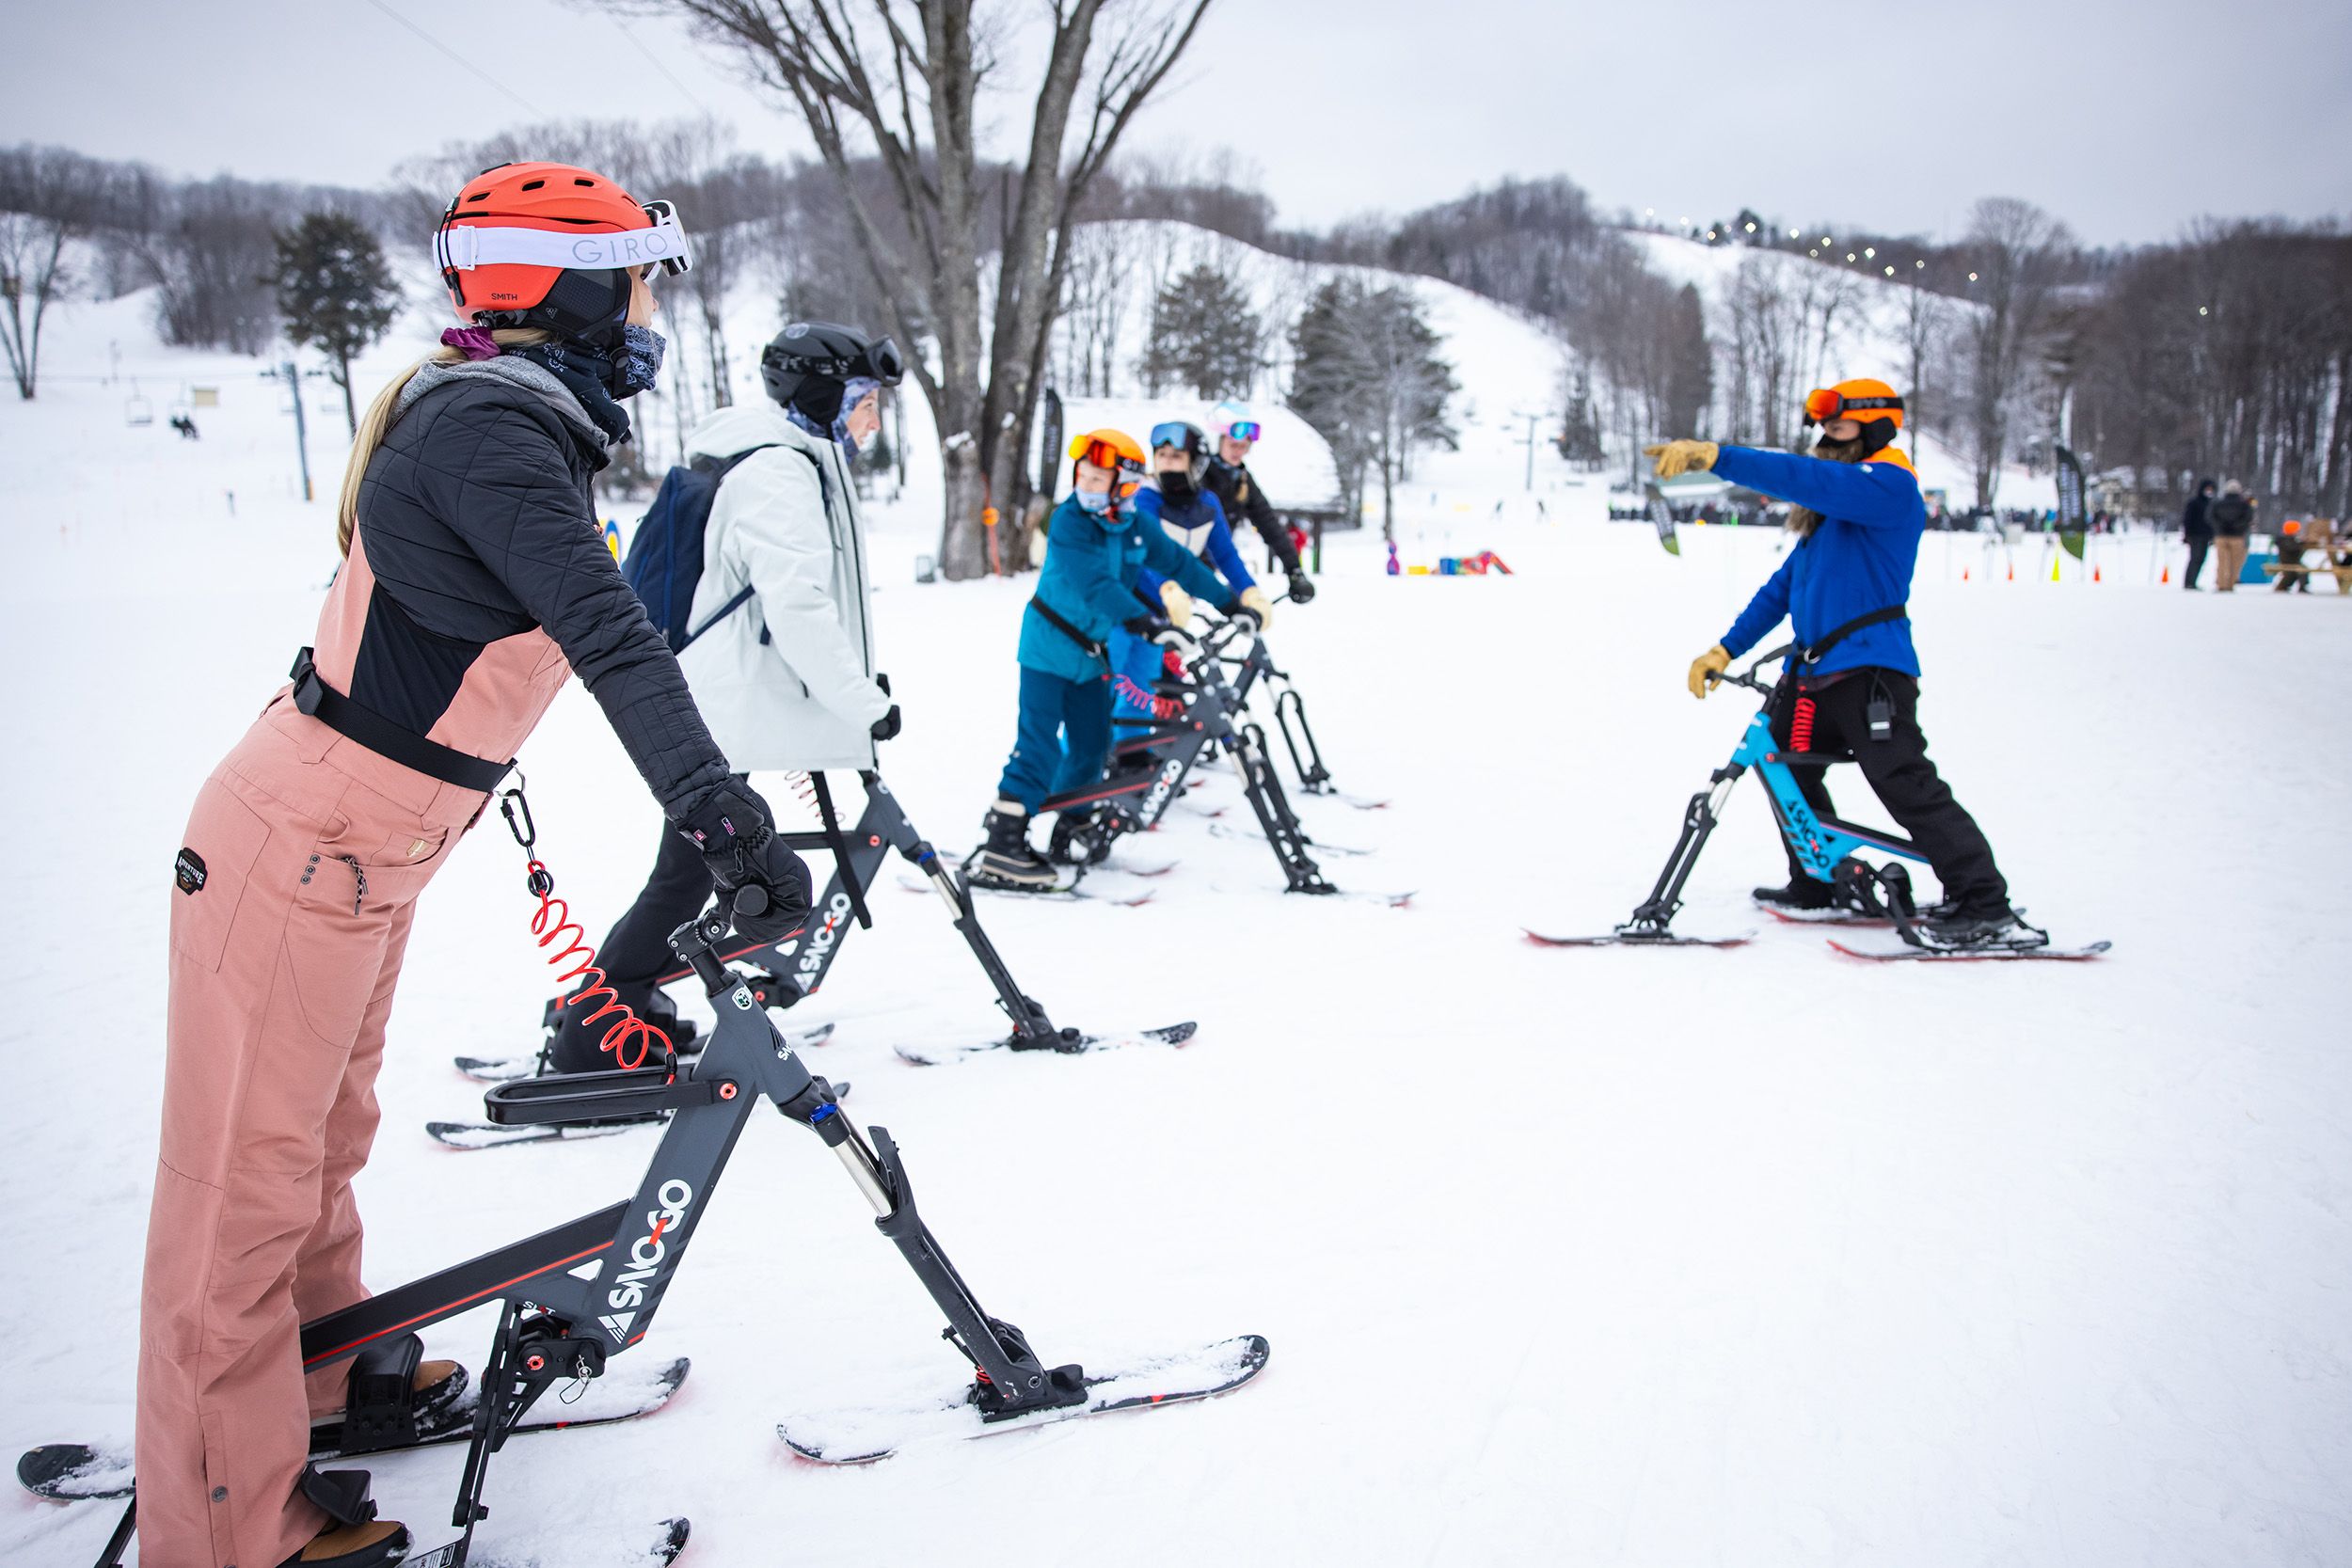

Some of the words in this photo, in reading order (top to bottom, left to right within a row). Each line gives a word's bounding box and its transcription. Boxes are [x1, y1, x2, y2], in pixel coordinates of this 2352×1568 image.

[572, 233, 668, 263] GIRO
[491, 293, 518, 301] SMITH
[608, 1179, 692, 1310] SNO-GO
